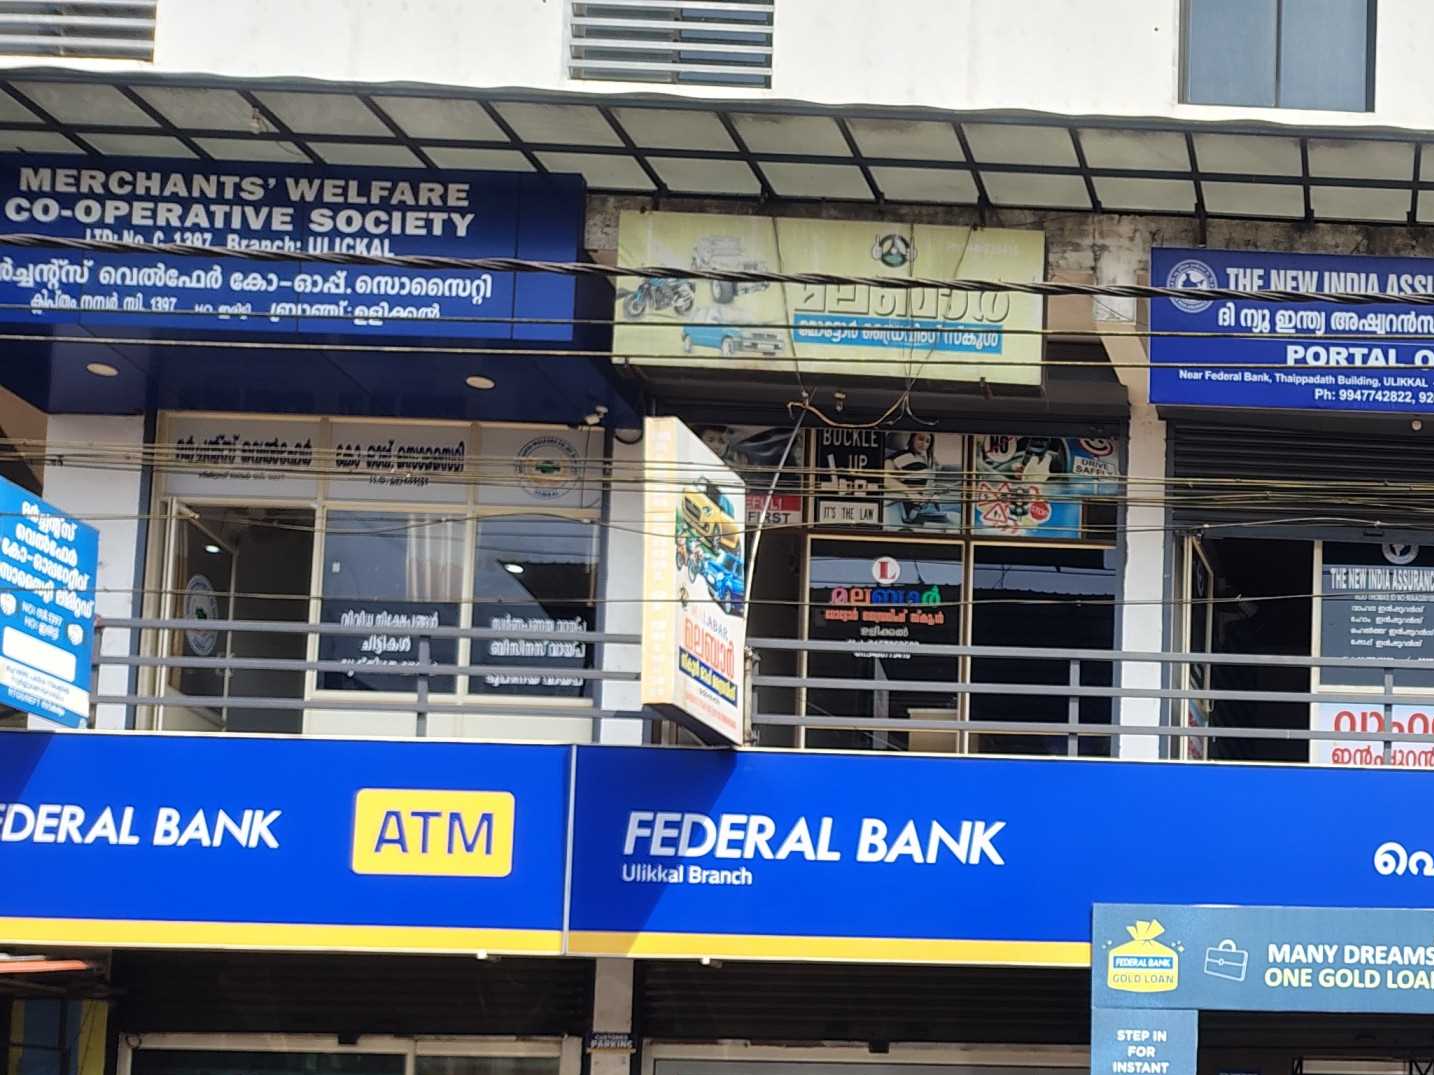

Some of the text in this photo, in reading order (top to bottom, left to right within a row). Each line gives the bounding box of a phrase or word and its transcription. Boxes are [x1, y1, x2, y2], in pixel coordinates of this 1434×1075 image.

[286, 177, 470, 207] WELFARE
[5, 198, 475, 237] CO-OPERATIVE SOCIETY
[1226, 267, 1265, 292] THE
[1270, 269, 1320, 294] NEW
[1324, 272, 1380, 296] INDIA
[1218, 302, 1236, 327] ദി
[1286, 344, 1405, 368] PORTAL
[1179, 369, 1429, 389] Near Federal Bank, Thaippadath Building, ULIKKAL
[1314, 388, 1336, 401] Ph:
[1338, 388, 1416, 404] 9947742822,
[822, 428, 879, 448] BUCKLE
[878, 561, 898, 580] L
[1330, 567, 1347, 590] THE
[1348, 568, 1366, 590] NEW
[1368, 569, 1391, 590] INDIA
[153, 807, 282, 850] BANK
[373, 809, 496, 856] ATM
[622, 811, 1008, 865] FEDERAL BANK
[621, 862, 753, 886] Ulikkal Branch
[1115, 957, 1172, 968] FEDERAL BANK
[1267, 943, 1339, 964] MANY
[1112, 973, 1175, 985] GOLD LOAN
[1264, 967, 1314, 988] ONE
[1318, 968, 1381, 989] GOLD
[1116, 1029, 1167, 1043] STEP IN
[1127, 1045, 1156, 1058] FOR
[1112, 1061, 1170, 1074] INSTANT
